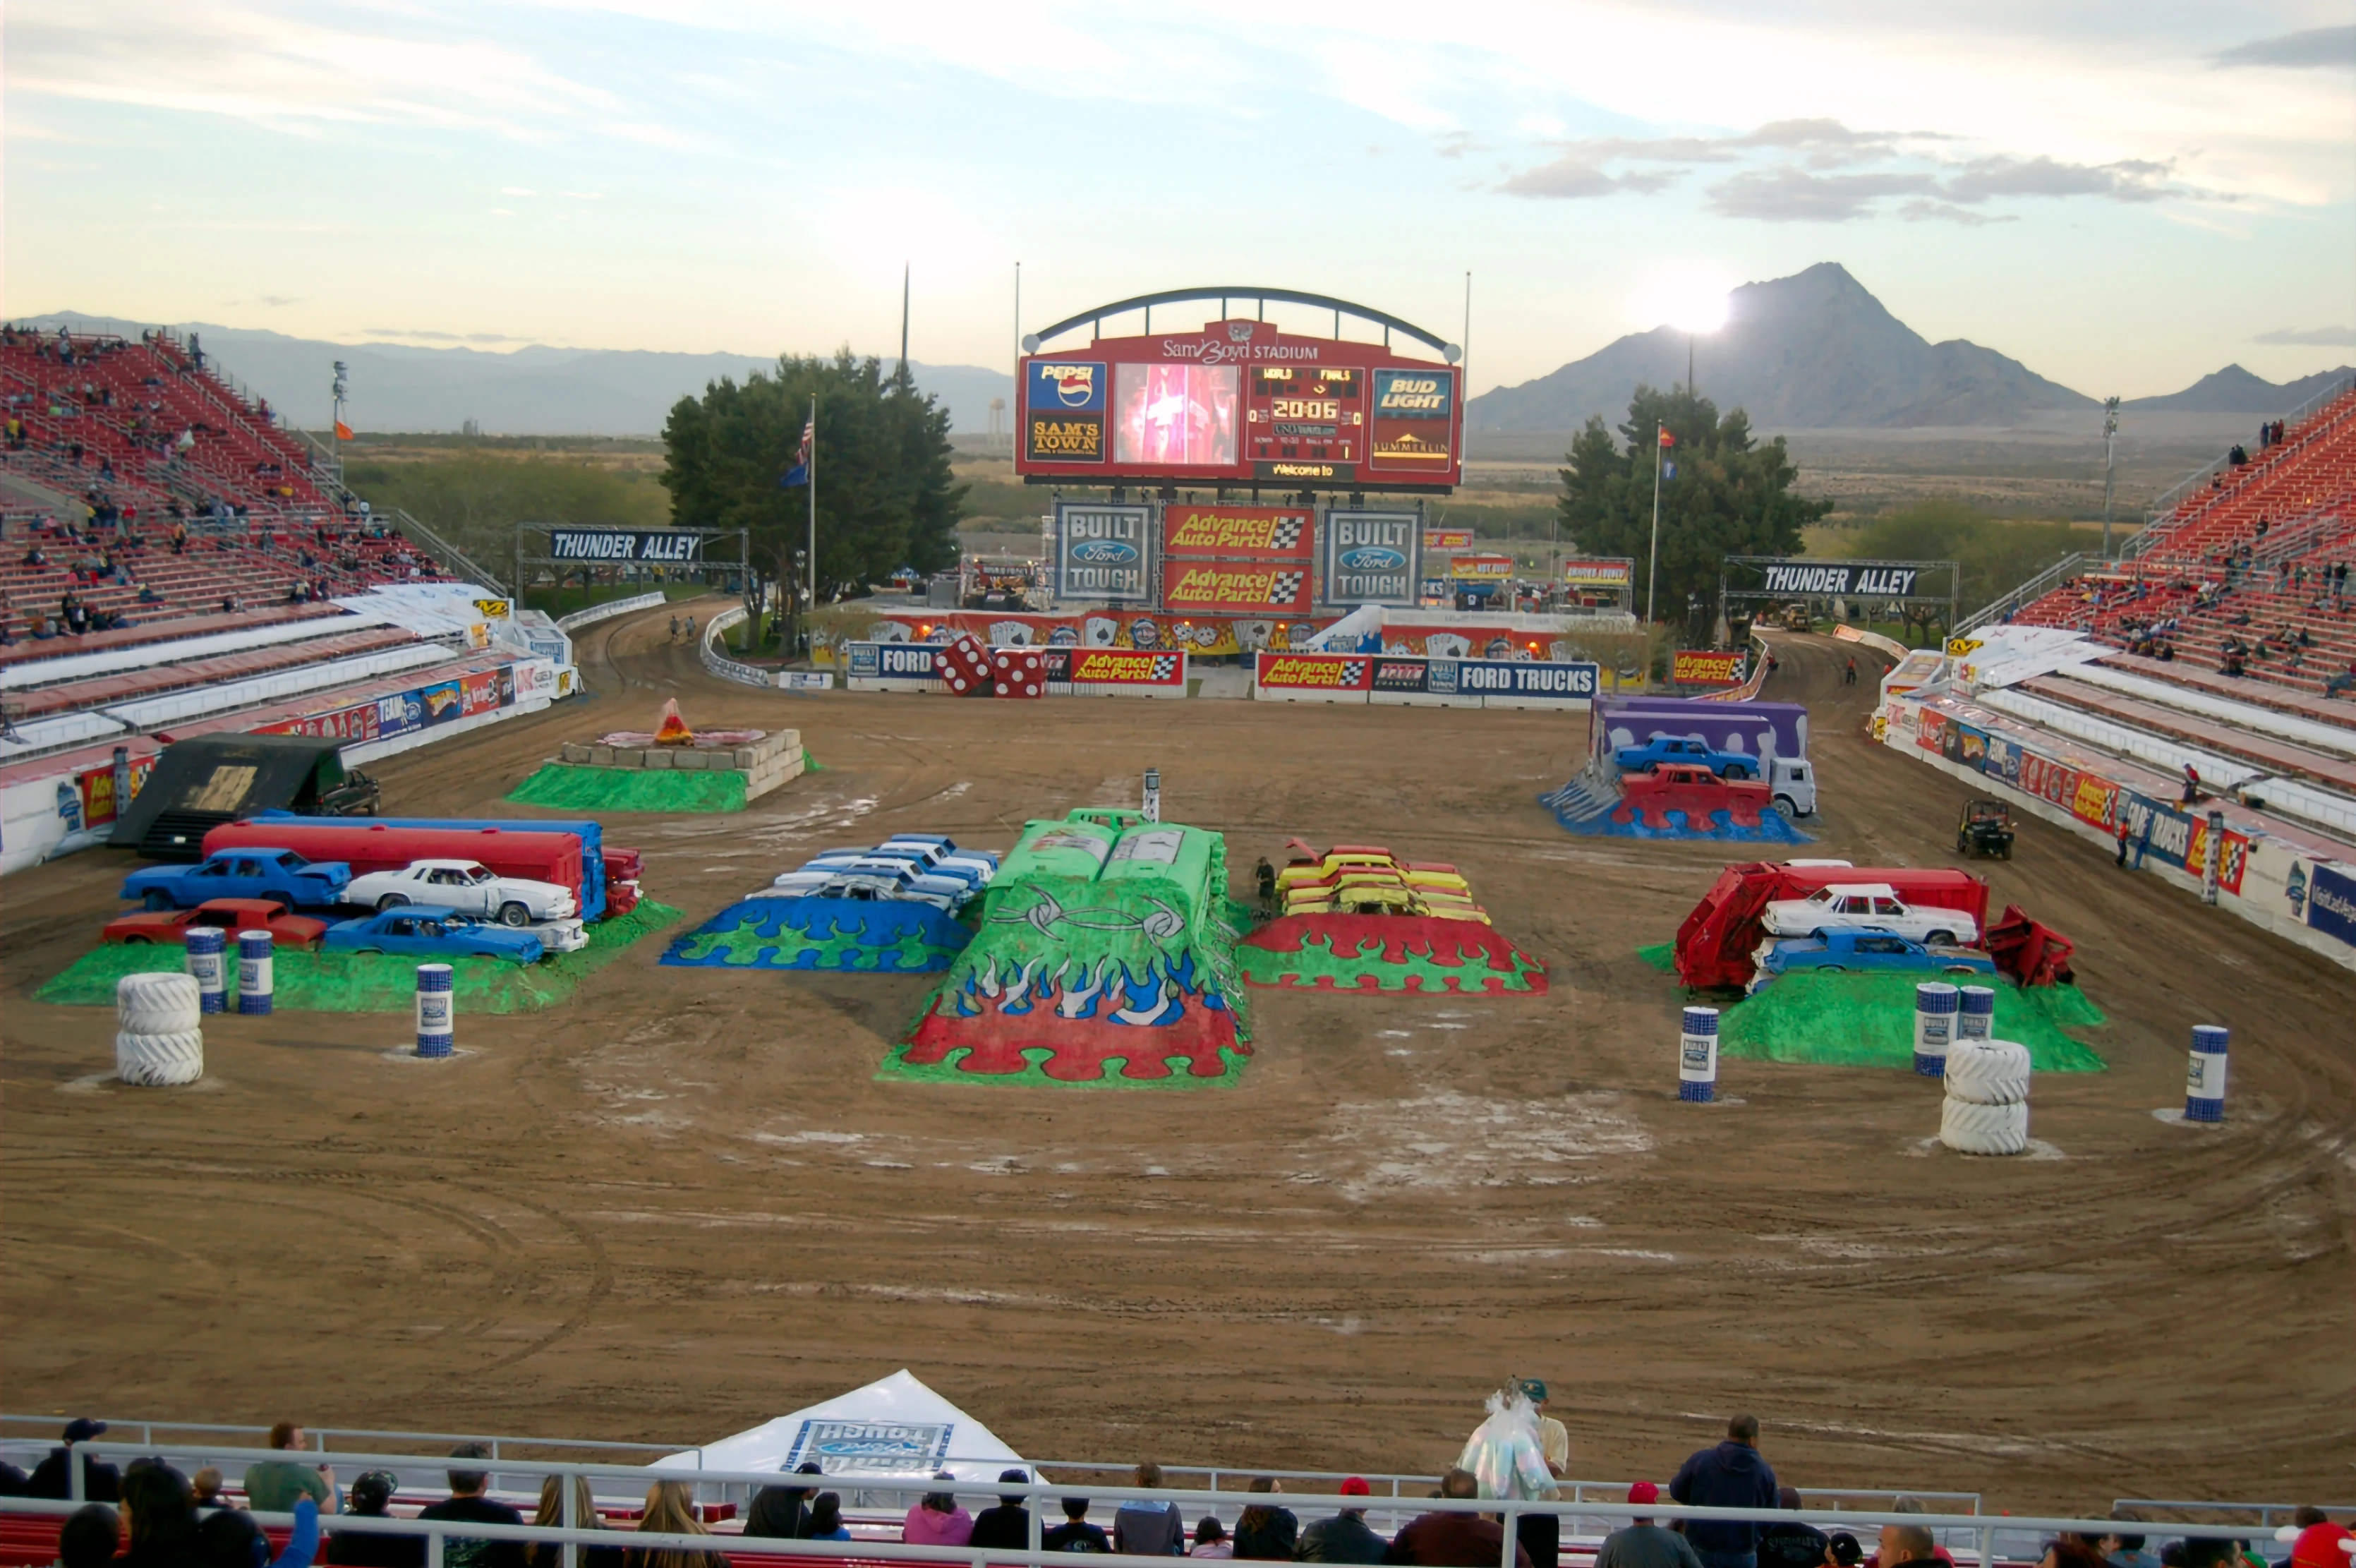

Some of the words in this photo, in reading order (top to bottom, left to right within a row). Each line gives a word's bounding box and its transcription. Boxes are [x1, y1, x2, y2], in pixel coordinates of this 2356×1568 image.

[1163, 339, 1197, 357] Sam
[1197, 339, 1250, 365] Boyd
[1255, 346, 1318, 359] STADIUM
[1041, 366, 1093, 380] PEPSI
[1390, 379, 1437, 393] BUD
[1274, 401, 1337, 418] 20:06
[1380, 394, 1445, 409] LIGHT
[1034, 422, 1098, 436] SAM'S
[1034, 435, 1101, 450] TOWN
[1374, 442, 1448, 452] SUMMERLIN
[1273, 464, 1320, 476] Welcome
[1322, 465, 1334, 476] to
[1070, 515, 1140, 538] BUILT
[1179, 514, 1270, 533] Advance
[1170, 531, 1216, 546] Auto
[1216, 531, 1266, 548] Parts
[1339, 521, 1408, 545] BUILT
[555, 533, 636, 558] THUNDER
[641, 536, 699, 560] ALLEY
[1070, 568, 1138, 590] TOUGH
[1178, 569, 1269, 588] Advance
[1338, 575, 1406, 596] TOUGH
[1765, 566, 1849, 592] THUNDER
[1854, 569, 1916, 594] ALLEY
[1168, 585, 1214, 601] Auto
[1214, 587, 1263, 602] Parts
[883, 651, 931, 672] FORD
[1084, 654, 1149, 668] Advance
[1271, 658, 1339, 673] Advance
[1075, 667, 1110, 679] Auto
[1110, 667, 1147, 680] Parts
[1262, 671, 1297, 683] Auto
[1298, 672, 1335, 685] Parts
[1462, 667, 1511, 689] FORD
[1516, 668, 1592, 692] TRUCKS
[821, 1425, 928, 1440] TOUGH
